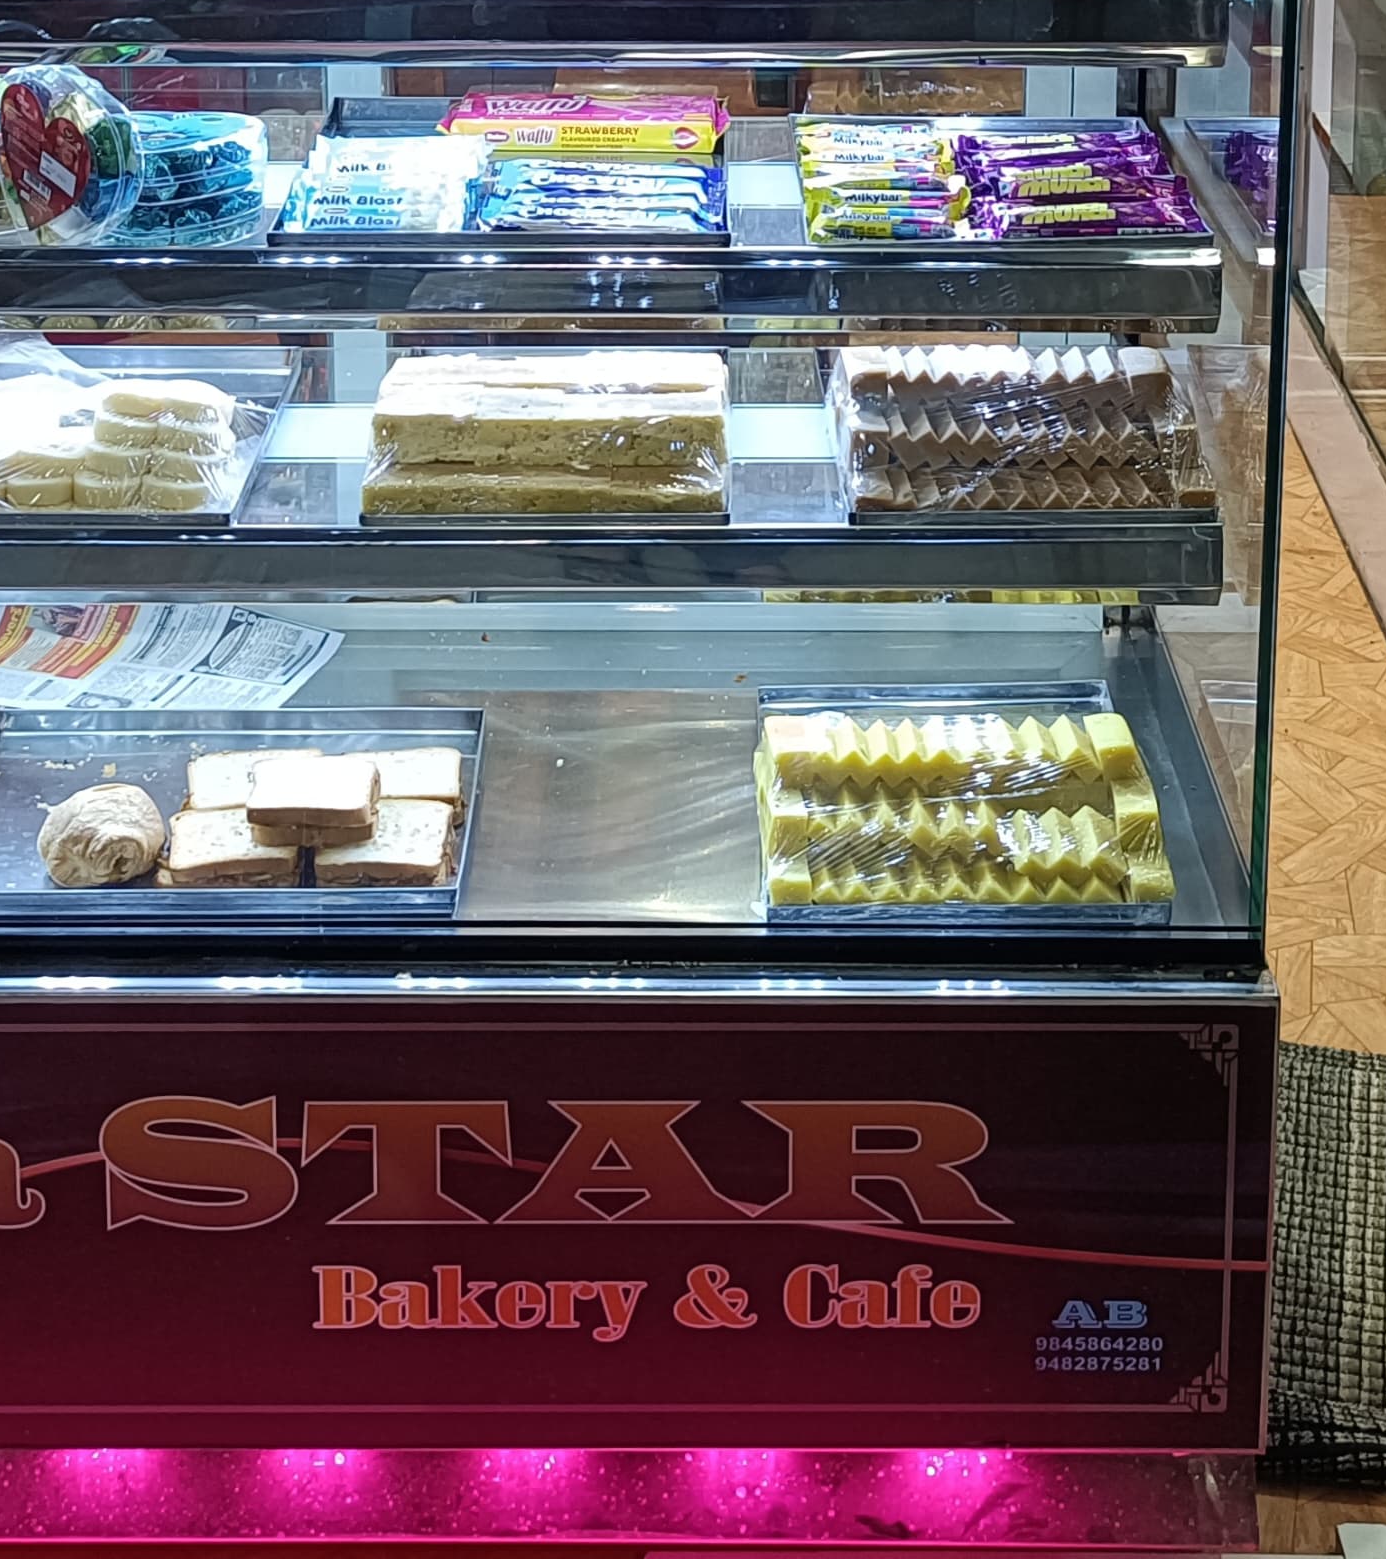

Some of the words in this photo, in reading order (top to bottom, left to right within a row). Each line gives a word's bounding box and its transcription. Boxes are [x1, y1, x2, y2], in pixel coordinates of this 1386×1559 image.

[561, 126, 640, 136] STRAWBERRY
[313, 195, 352, 207] Milk
[845, 192, 904, 204] Milkybar
[310, 215, 352, 228] Milk
[99, 1095, 1015, 1231] STAR
[311, 1263, 648, 1343] Bakery
[672, 1263, 758, 1330] &
[782, 1263, 981, 1331] Cafe
[1051, 1300, 1148, 1328] AB
[1035, 1336, 1164, 1352] 9845864280
[1034, 1356, 1162, 1372] 9482875281
